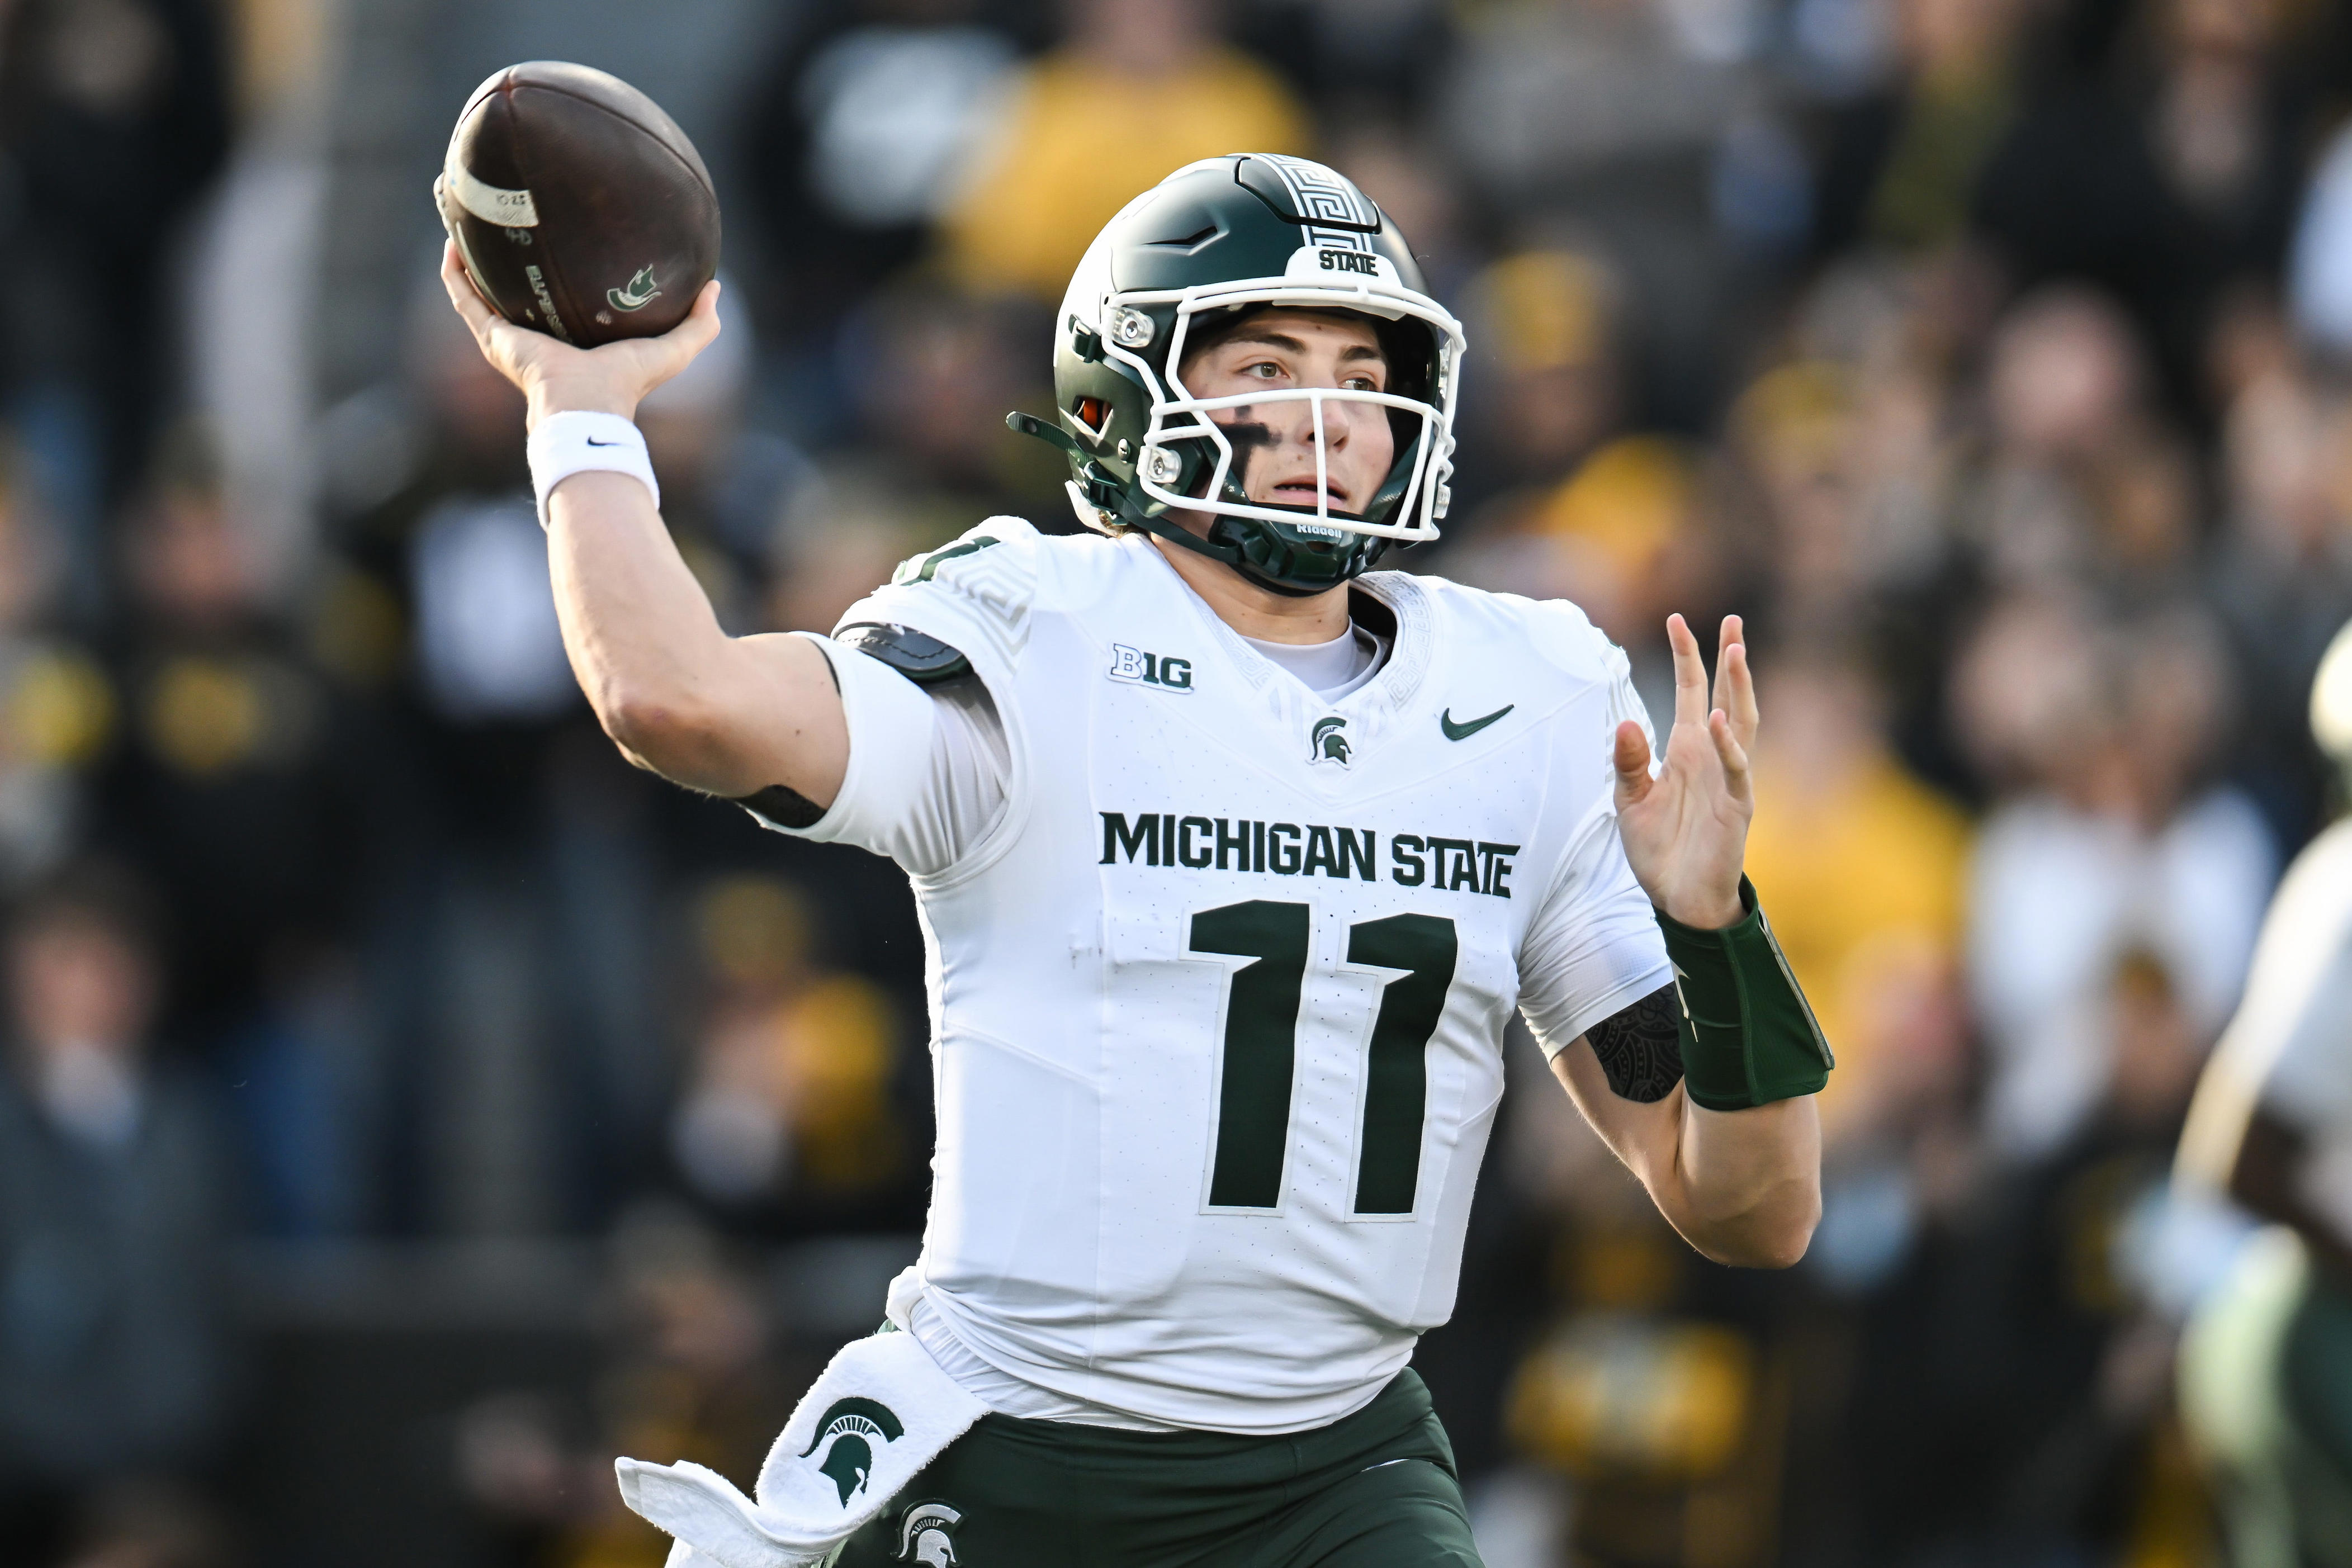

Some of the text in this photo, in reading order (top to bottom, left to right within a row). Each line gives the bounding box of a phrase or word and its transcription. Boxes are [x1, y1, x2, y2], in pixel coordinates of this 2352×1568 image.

[1319, 250, 1379, 277] STATE
[1099, 812, 1521, 899] MICHIGAN STATE
[1186, 899, 1460, 1216] 11
